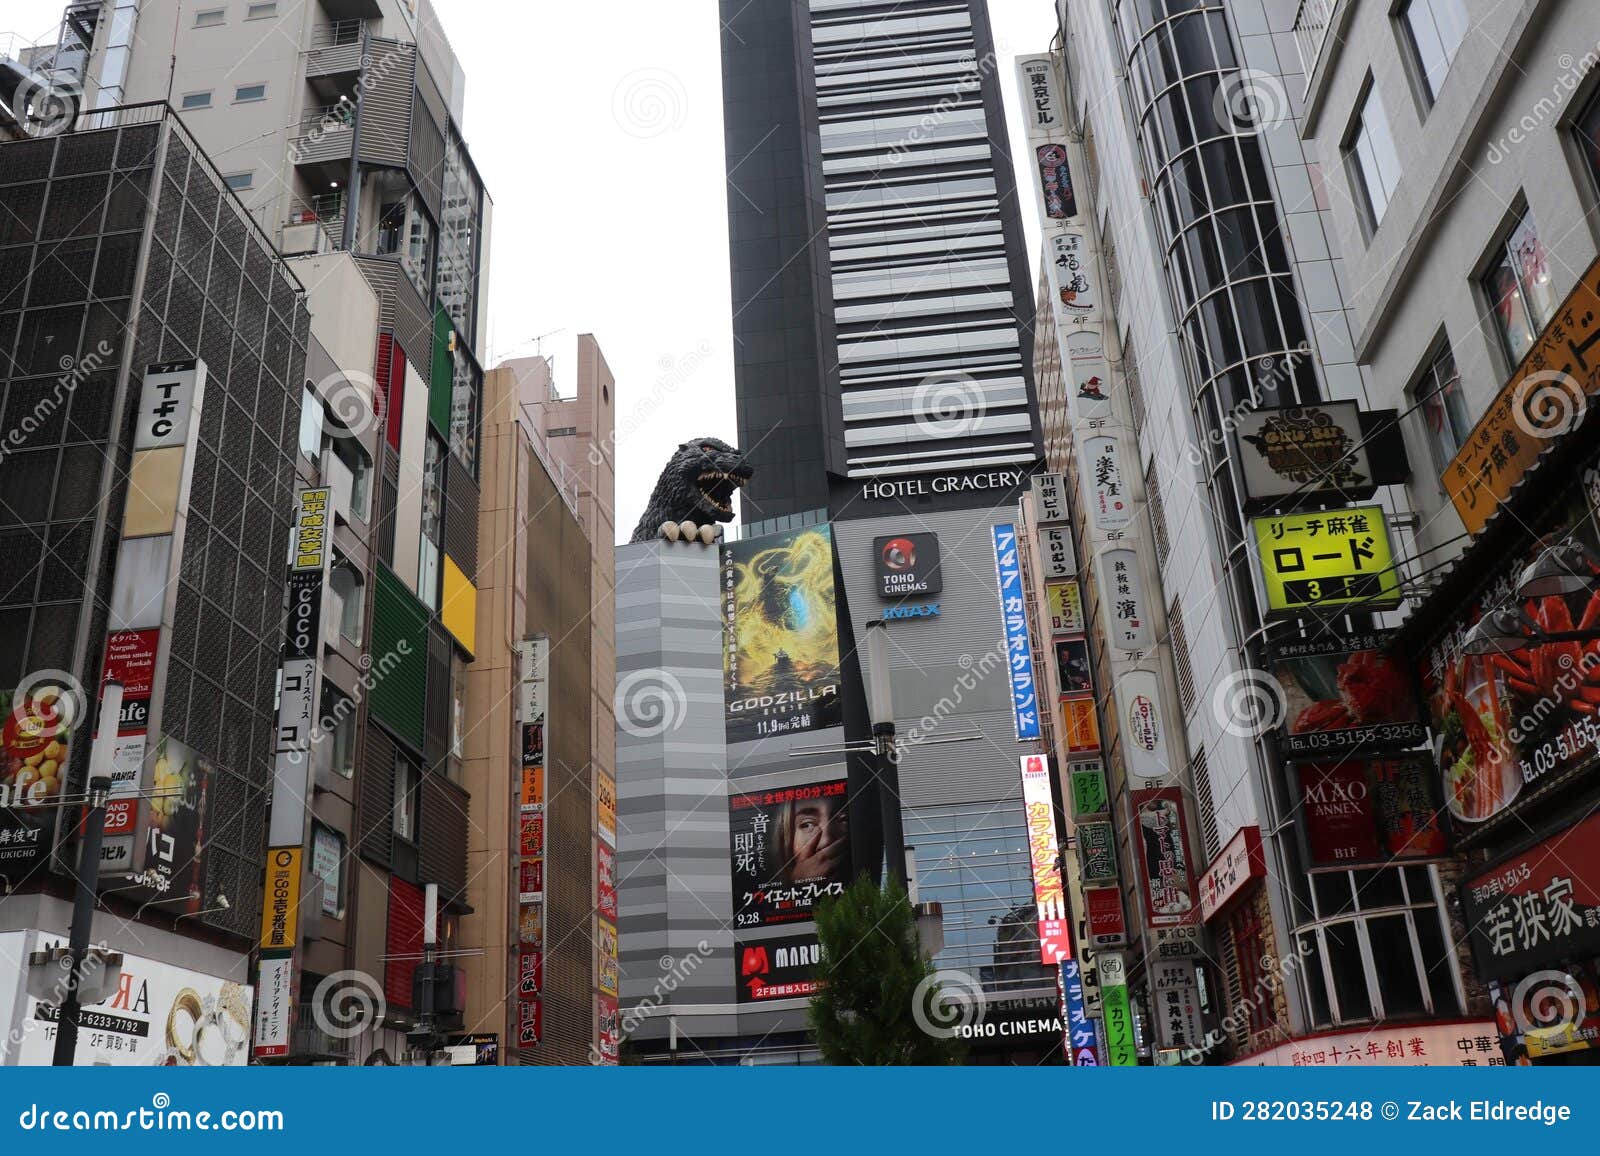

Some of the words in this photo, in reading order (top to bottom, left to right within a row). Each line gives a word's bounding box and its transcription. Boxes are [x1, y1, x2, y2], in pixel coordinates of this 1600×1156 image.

[1031, 73, 1054, 124] 東京ビル
[863, 480, 928, 499] HOTEL
[932, 470, 1023, 492] GRACERY
[1107, 532, 1124, 540] 6F
[1271, 515, 1370, 540] リーチ麻雀
[997, 532, 1018, 589] 747
[1273, 537, 1375, 573] ロード
[884, 574, 915, 584] TOHO
[1114, 561, 1131, 596] 鉄板焼
[884, 582, 928, 593] CINEMAS
[883, 604, 940, 619] IMAX
[132, 651, 152, 659] smoke
[1006, 596, 1035, 731] カラオケランド
[1126, 652, 1143, 660] 7F
[124, 683, 149, 692] eesha
[301, 663, 312, 718] ヘアースペース
[730, 684, 837, 712] GODZILLA
[112, 770, 136, 782] HANGE
[527, 768, 537, 804] 299円
[1305, 780, 1367, 804] MAO
[107, 804, 129, 812] AND
[1316, 801, 1362, 816] ANNEX
[104, 812, 128, 828] 29
[1, 850, 36, 859] UKICHO
[735, 832, 757, 877] 即死。
[1334, 847, 1357, 859] B1F
[738, 911, 760, 926] 9.28
[1485, 877, 1583, 957] 若狭家
[1159, 941, 1200, 958] 東京ビル
[48, 1007, 61, 1019] TE
[1166, 990, 1186, 1046] 磯丸水産
[952, 1023, 996, 1038] TOHO
[1000, 1018, 1062, 1036] CINEMA
[90, 1033, 104, 1047] 2F
[1291, 1037, 1427, 1066] 昭和四十六年創業
